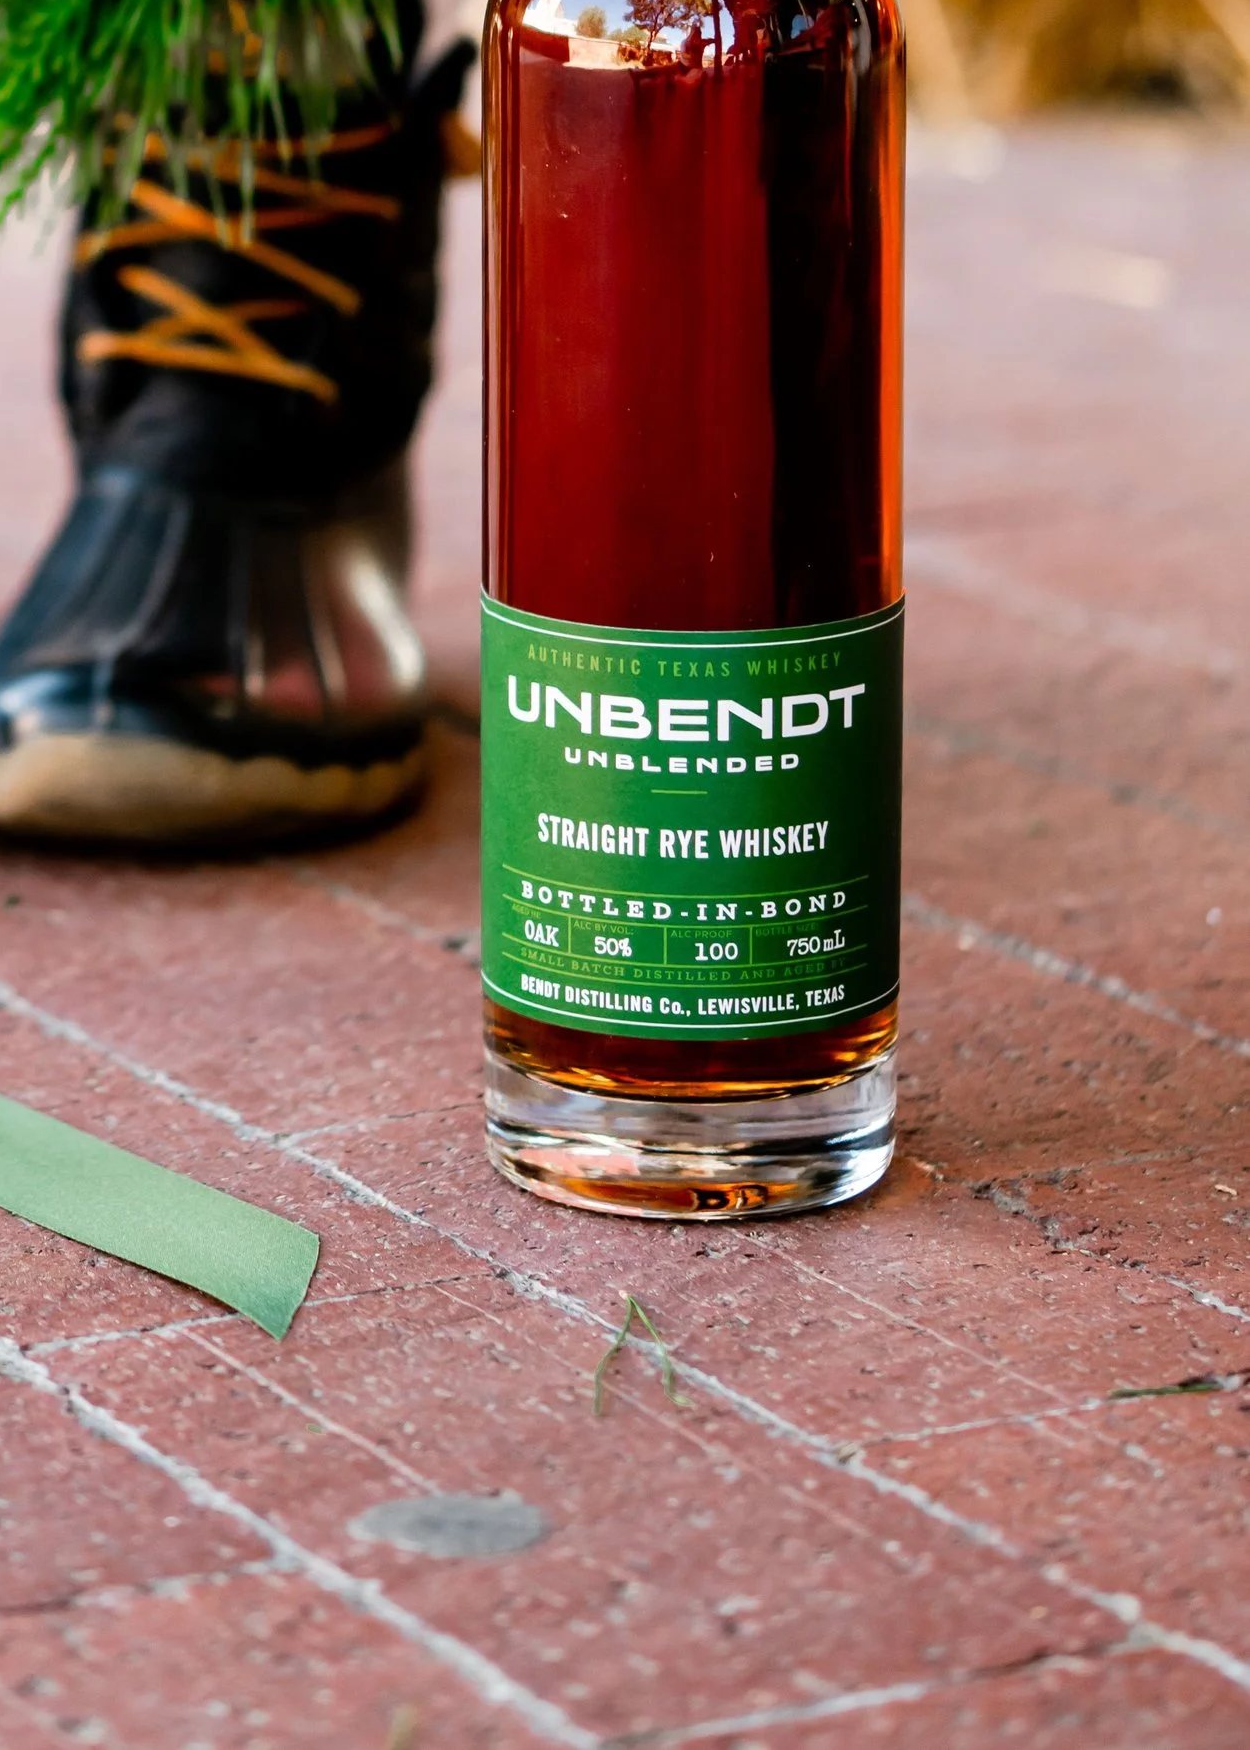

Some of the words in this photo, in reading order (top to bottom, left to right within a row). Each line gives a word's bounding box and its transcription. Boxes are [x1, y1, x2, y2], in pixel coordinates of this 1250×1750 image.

[528, 643, 641, 675] AUTHENTIC
[658, 660, 731, 678] TEXAS
[747, 651, 841, 676] WHISKEY
[508, 674, 866, 742] UNBENDT
[564, 746, 800, 774] UNBLENDED
[538, 812, 649, 857] STRAIGHT
[660, 829, 710, 859] RYE
[719, 820, 829, 859] WHISKEY
[521, 880, 846, 921] BOTTLED-IN-BOND
[524, 919, 560, 947] OAK
[573, 920, 592, 931] ALC
[594, 923, 608, 932] BY
[610, 925, 634, 935] VOL:
[670, 930, 691, 939] ALC
[594, 936, 633, 957] 50%
[695, 942, 739, 961] 100
[521, 947, 565, 967] SMALL
[571, 961, 625, 977] BATCH
[633, 969, 731, 981] DISTILLED
[740, 969, 775, 980] AND
[784, 962, 825, 977] AGED
[521, 973, 560, 1000] BENDT
[564, 985, 652, 1013] DISTILLING
[659, 997, 691, 1017] Co.,
[698, 993, 800, 1015] LEWISVILLE,
[805, 984, 845, 1007] TEXAS
